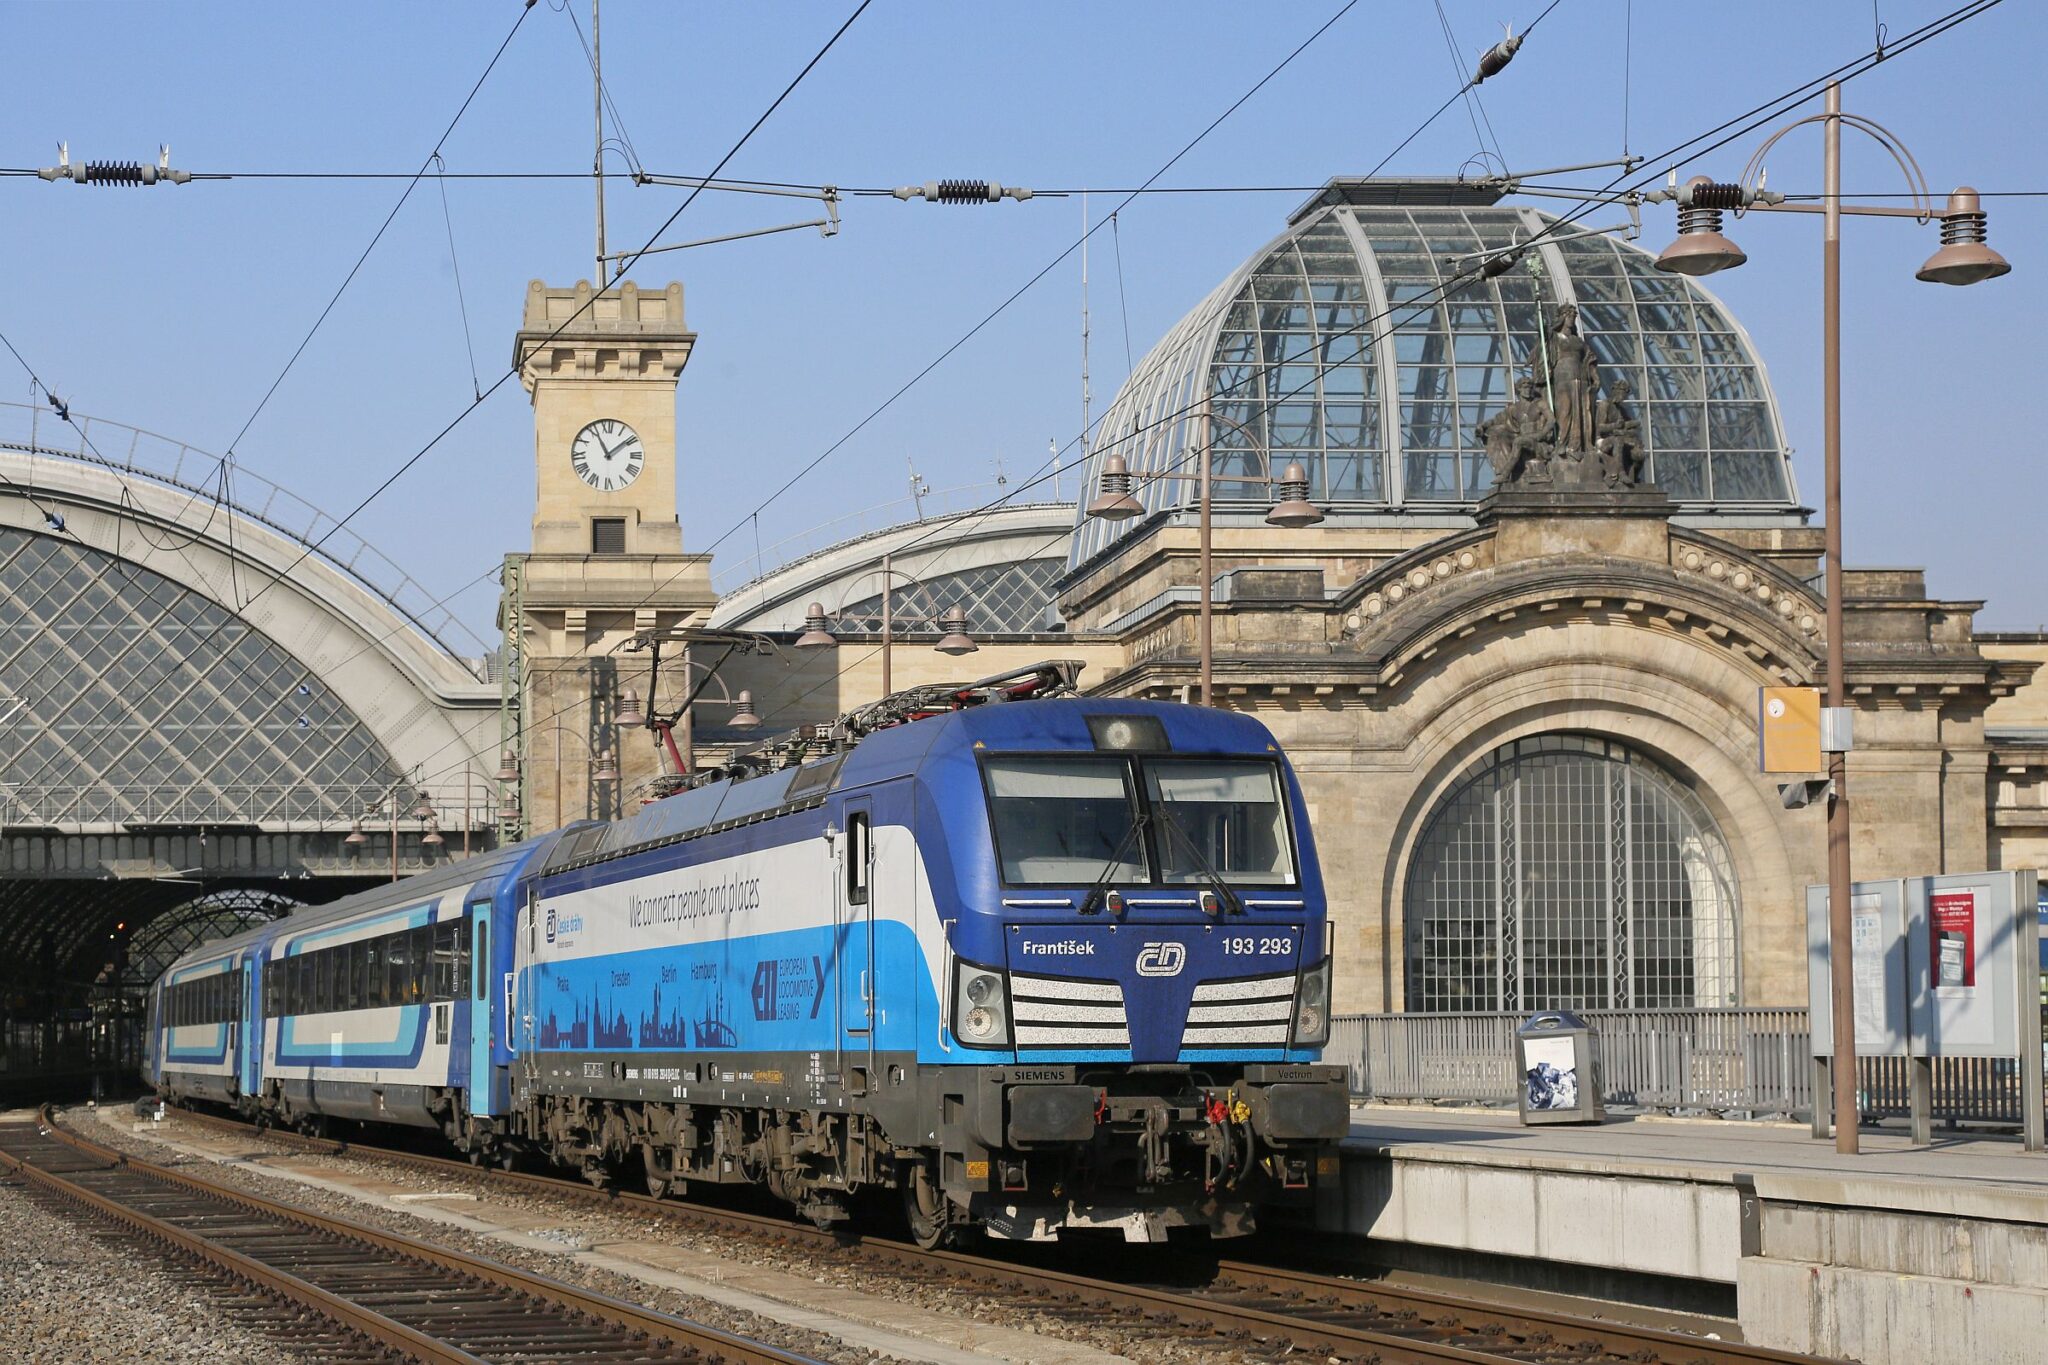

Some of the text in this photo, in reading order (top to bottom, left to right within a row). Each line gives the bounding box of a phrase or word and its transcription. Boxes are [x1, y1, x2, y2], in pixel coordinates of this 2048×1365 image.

[629, 872, 760, 931] We connect people and places
[1023, 940, 1094, 955] František
[1222, 938, 1291, 955] 193 293
[661, 964, 677, 984] Berlin
[691, 960, 717, 985] Hamburg
[779, 957, 807, 977] EUROPEAN
[557, 976, 569, 992] Praha
[611, 969, 631, 988] Dresden
[778, 979, 814, 999] LOCOMOTIVE
[777, 1002, 800, 1021] LEASING
[1014, 1071, 1065, 1081] SIEMENS
[1278, 1070, 1312, 1079] Vectron
